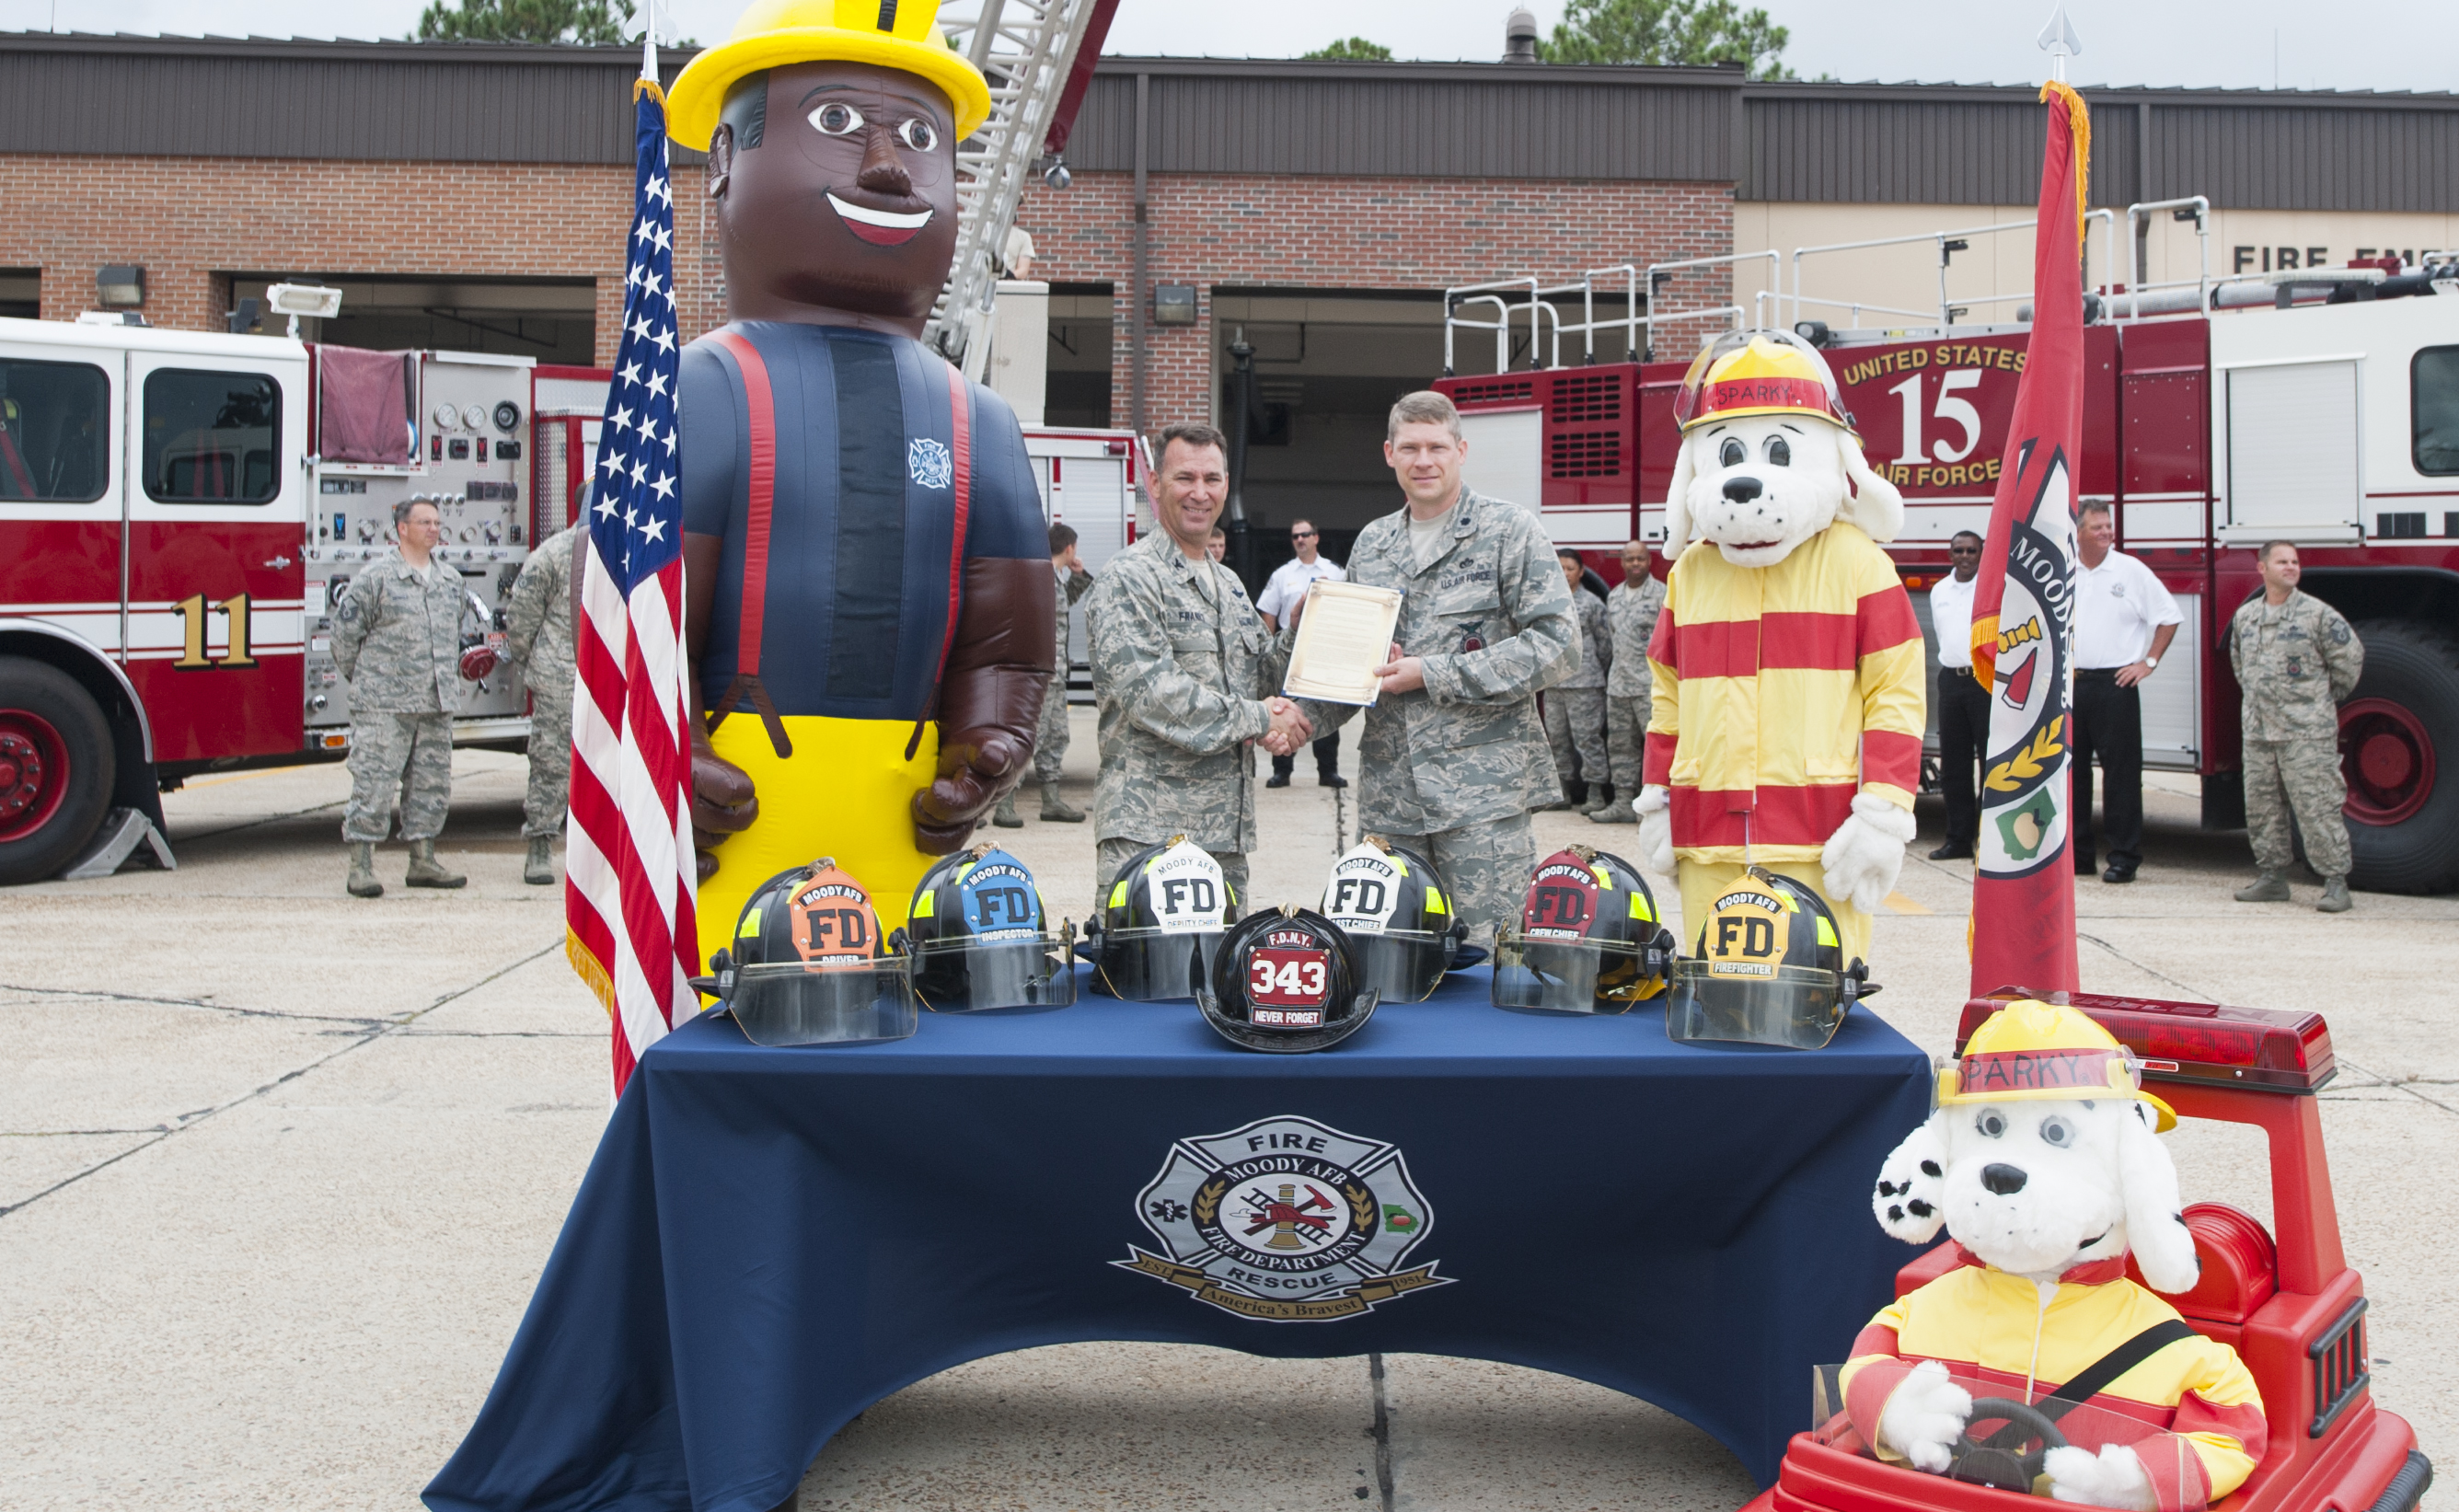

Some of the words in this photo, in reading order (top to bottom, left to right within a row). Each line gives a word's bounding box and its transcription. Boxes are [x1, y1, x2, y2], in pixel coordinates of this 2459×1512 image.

[2234, 246, 2327, 273] FIRE
[1843, 348, 1930, 386] UNITED
[1935, 345, 2026, 373] STATES
[1717, 385, 1791, 405] SPARKY
[1888, 368, 1982, 463] 15
[1873, 462, 1911, 485] AIR
[1917, 458, 2001, 487] FORCE
[1454, 576, 1465, 587] AIR
[1467, 571, 1492, 583] FORCE
[170, 592, 260, 672] 11
[968, 865, 1007, 886] MOODY
[1010, 867, 1027, 883] AFB
[1157, 857, 1194, 876] MOODY
[1197, 860, 1214, 874] AFB
[1339, 858, 1371, 874] MOODY
[1370, 861, 1391, 877] AFB
[1538, 865, 1572, 882] MOODY
[1569, 868, 1590, 884] AFB
[802, 885, 843, 906] MOODY
[844, 887, 862, 905] AFB
[1162, 878, 1216, 915] FD
[1332, 878, 1386, 915] FD
[1531, 886, 1585, 925] FD
[1717, 893, 1756, 910] MOODY
[1754, 895, 1777, 911] AFB
[976, 887, 1031, 927] FD
[806, 908, 866, 950] FD
[1167, 919, 1196, 929] DEPUTY
[1352, 918, 1380, 929] CHIEF
[981, 928, 1034, 942] INSPECTOR
[1269, 931, 1310, 947] F.D.N.Y.
[1553, 929, 1579, 940] CHIEF
[1716, 917, 1774, 957] FD
[1252, 960, 1325, 995] 343
[1714, 963, 1772, 975] FIREFIGHTER
[1254, 1010, 1283, 1023] NEVER
[1286, 1011, 1319, 1023] FORGET
[1247, 1133, 1328, 1153] FIRE
[1224, 1157, 1305, 1183] MOODY
[1306, 1161, 1347, 1185] AFB
[1200, 1226, 1238, 1259] FIRE
[1239, 1230, 1367, 1270] DEPARTMENT
[1143, 1259, 1172, 1276] EST.
[1227, 1266, 1338, 1289] RESCUE
[1393, 1274, 1422, 1287] 1951
[1204, 1289, 1288, 1315] America's
[1295, 1298, 1358, 1316] Bravest
